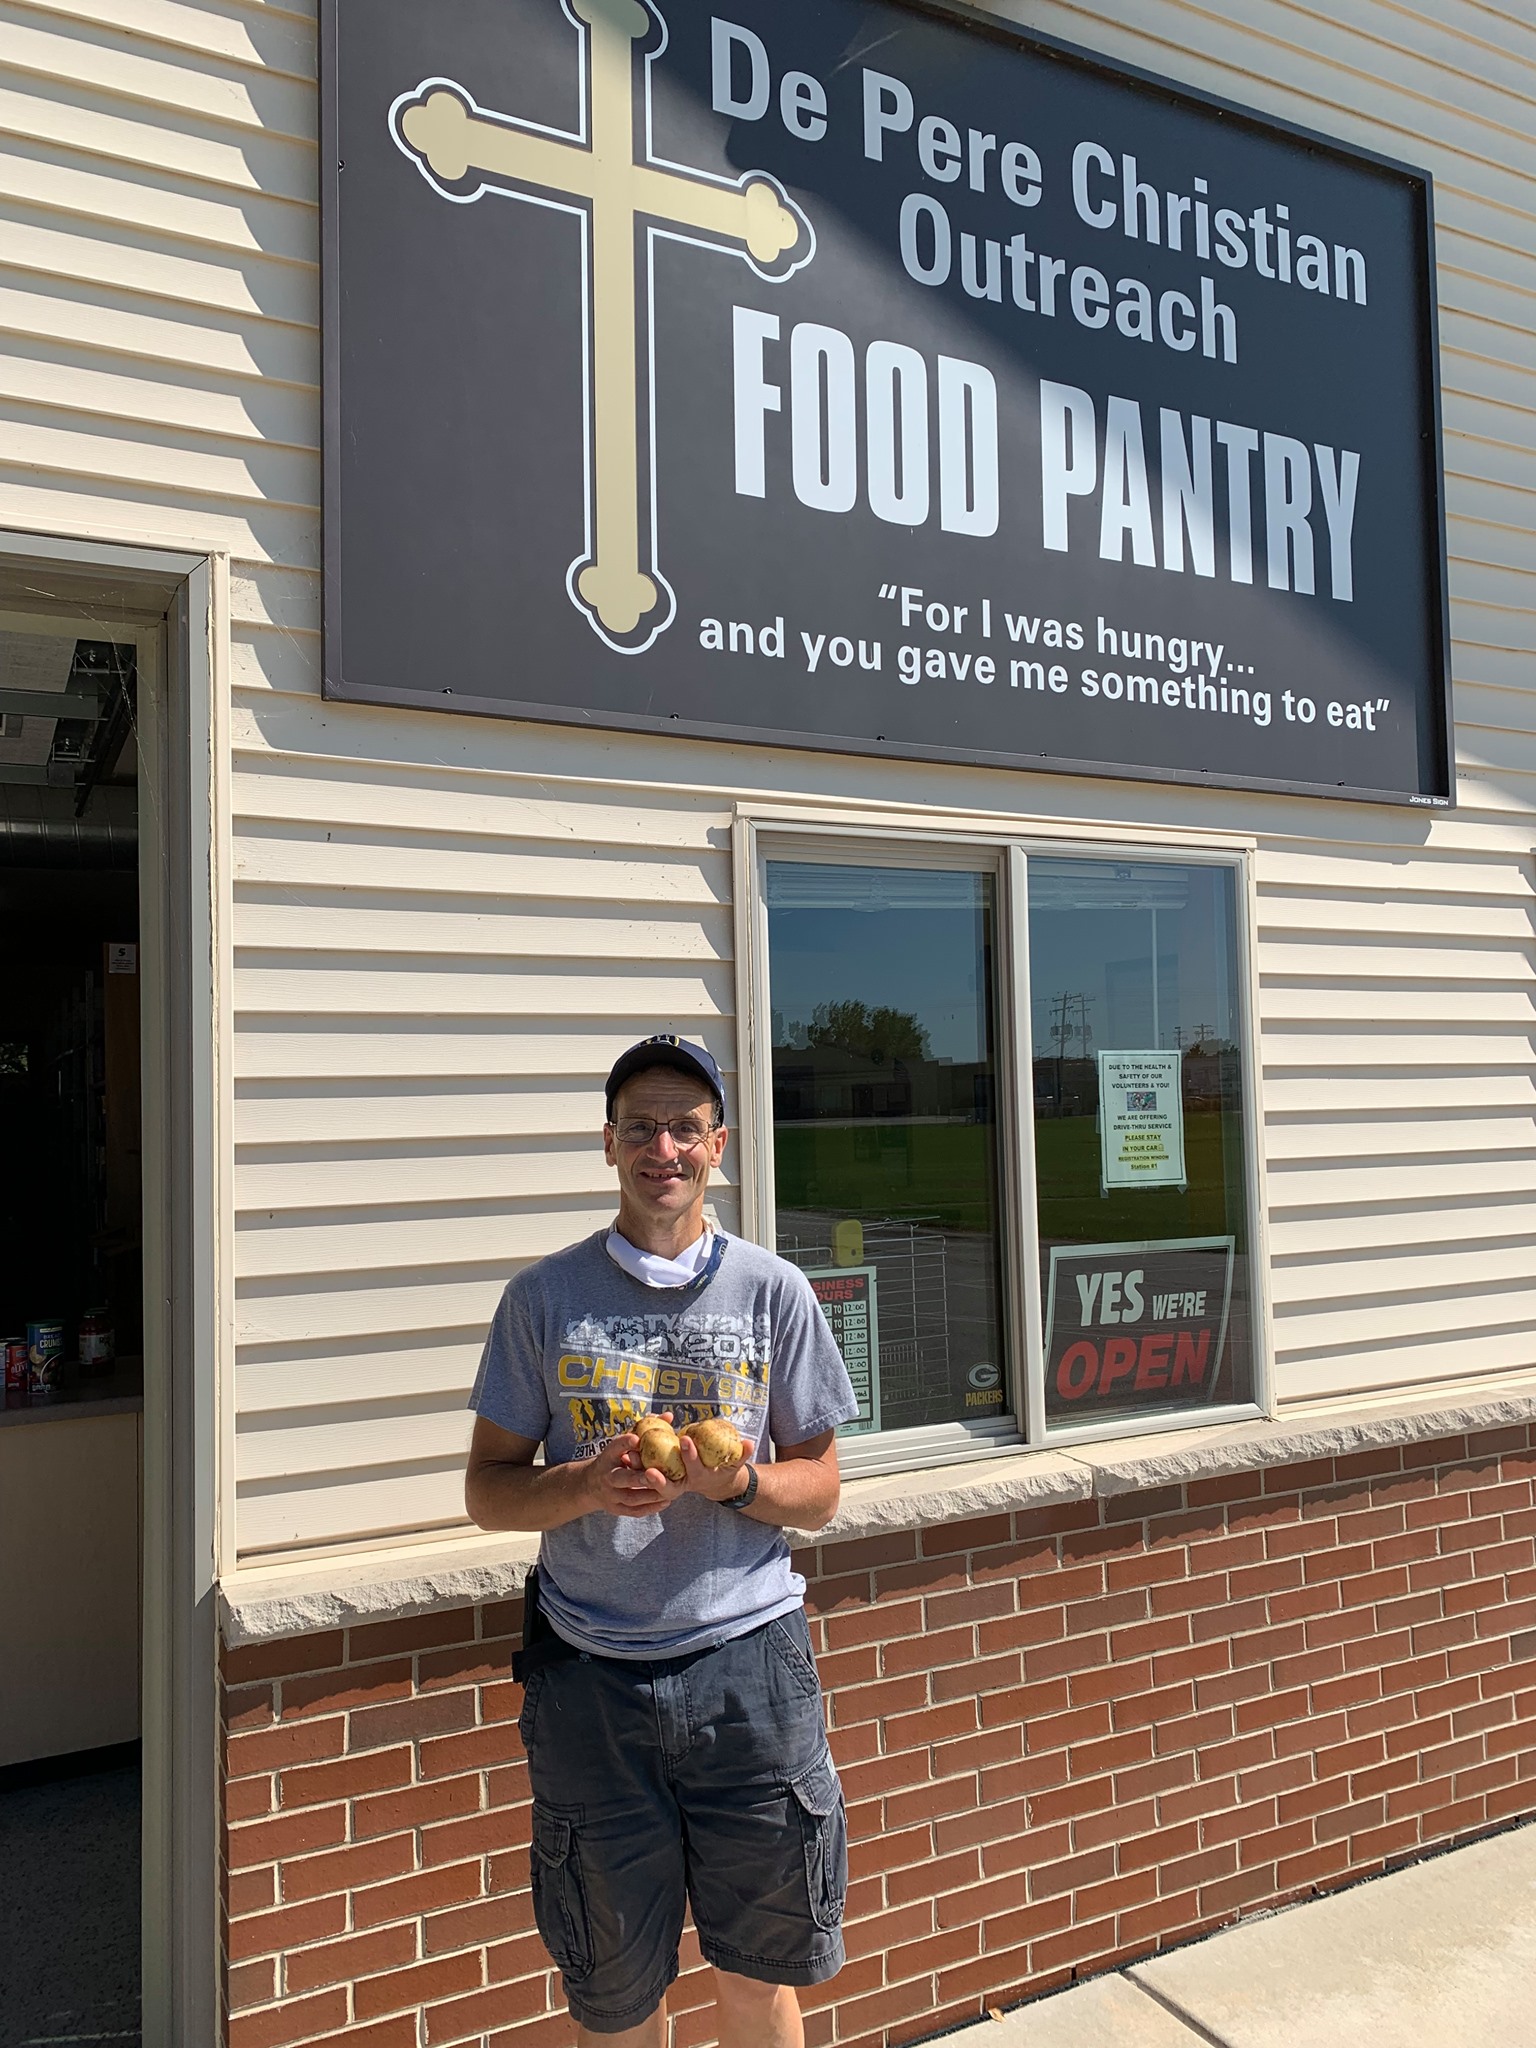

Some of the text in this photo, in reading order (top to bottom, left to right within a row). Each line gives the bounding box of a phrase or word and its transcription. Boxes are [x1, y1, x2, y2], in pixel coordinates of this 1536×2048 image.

[711, 16, 1367, 306] De Pere Christian
[899, 192, 1238, 364] Outreach
[733, 305, 1360, 602] FOOD PANTRY
[982, 599, 991, 638] I
[1004, 613, 1084, 650] was
[1097, 616, 1254, 678] hungry...
[699, 616, 785, 659] and
[800, 631, 882, 673] you
[897, 644, 996, 685] gave
[1010, 659, 1068, 693] me
[1081, 668, 1272, 727] something
[1282, 690, 1316, 723] to
[812, 1278, 864, 1291] SINESS
[1075, 1269, 1145, 1327] YES
[833, 1304, 842, 1313] TO
[844, 1303, 865, 1312] 12:00
[1152, 1290, 1207, 1321] WE'RE
[834, 1318, 866, 1328] TO 12:00
[845, 1332, 865, 1341] 12:00
[845, 1347, 866, 1355] 12:00
[1056, 1328, 1211, 1400] OPEN
[965, 1388, 1004, 1407] PACKERS
[575, 1441, 597, 1458] 29TH
